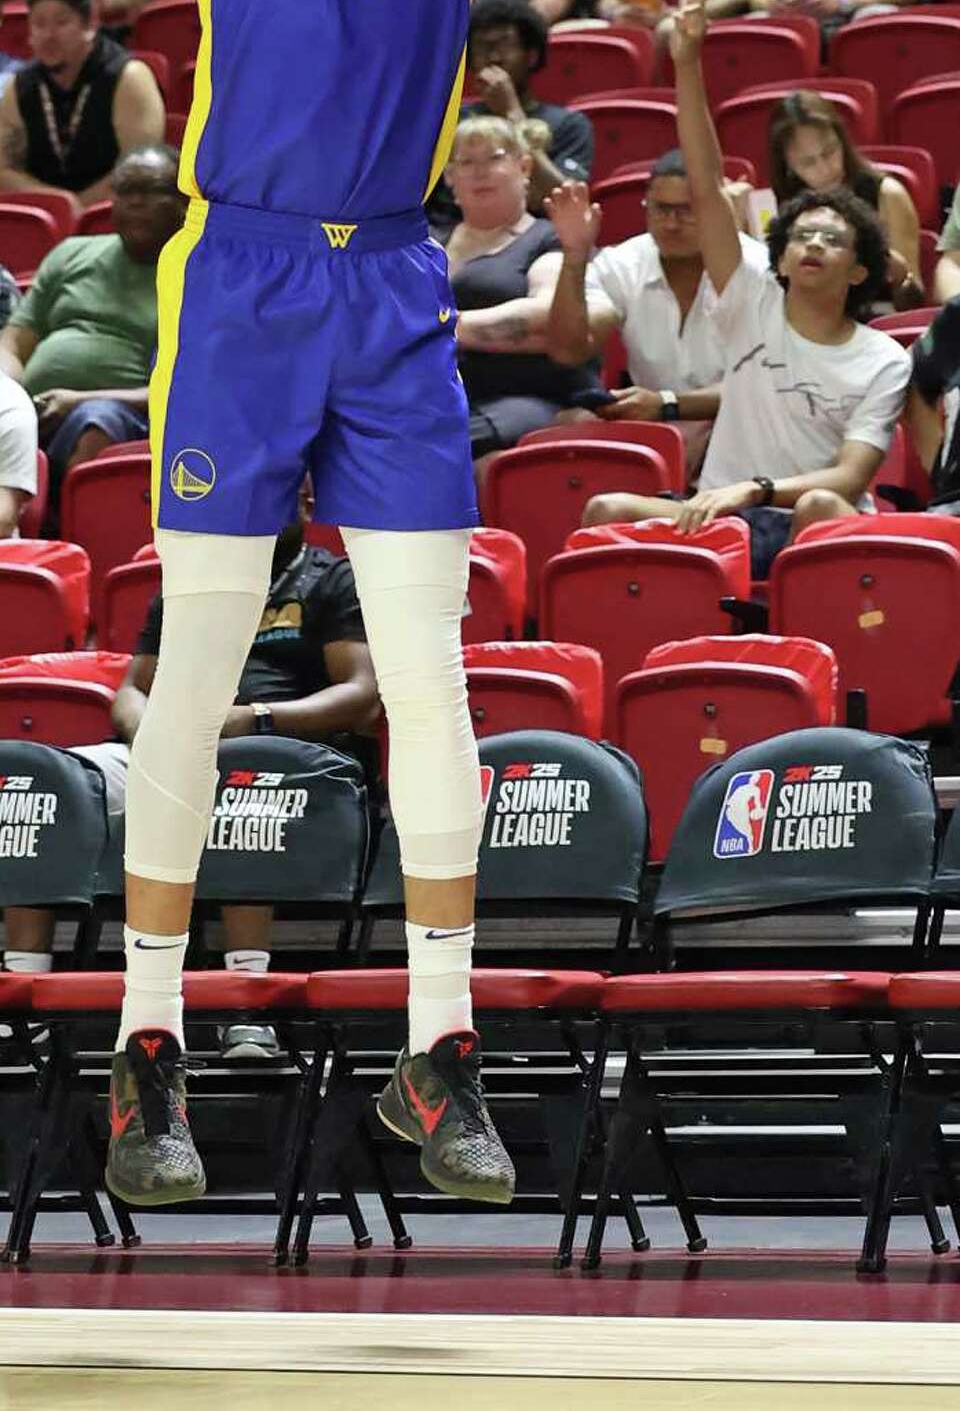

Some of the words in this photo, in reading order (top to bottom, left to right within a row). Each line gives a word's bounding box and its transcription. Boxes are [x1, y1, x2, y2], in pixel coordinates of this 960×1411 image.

[214, 788, 308, 818] SUMMER
[496, 779, 591, 813] SUMMER
[776, 781, 873, 819] SUMMER
[206, 816, 288, 852] LEAGUE
[490, 812, 573, 848] LEAGUE
[720, 837, 744, 853] NBA
[771, 815, 856, 852] LEAGUE
